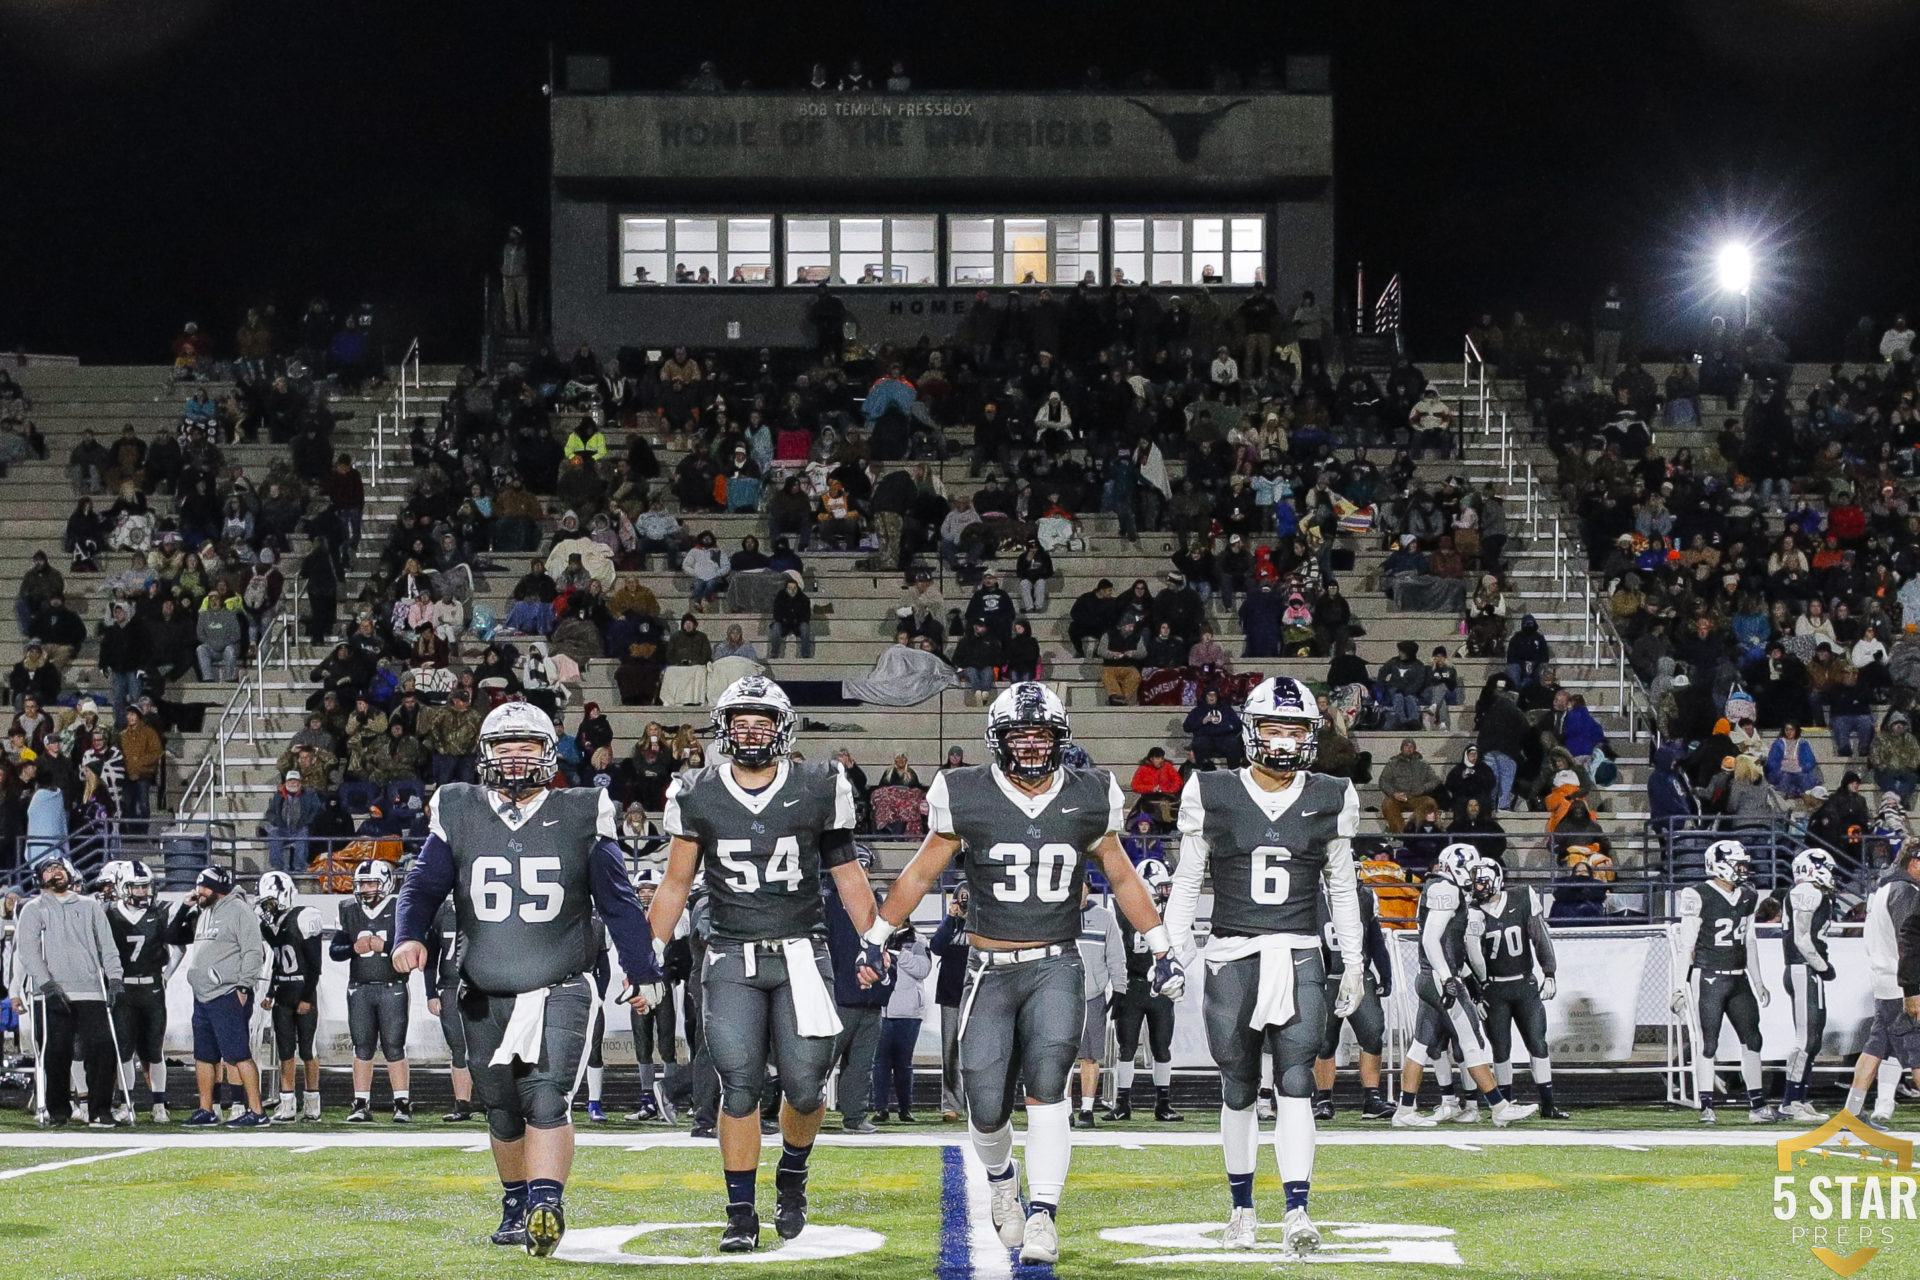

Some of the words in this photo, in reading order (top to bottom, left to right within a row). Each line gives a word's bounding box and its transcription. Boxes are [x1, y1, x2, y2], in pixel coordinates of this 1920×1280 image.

[799, 103, 828, 116] BOB
[835, 103, 892, 116] TEMPLIN
[898, 103, 973, 116] PRESSBOX
[659, 120, 756, 148] HOME
[778, 120, 826, 148] OF
[924, 119, 1113, 148] MAVERICKS
[889, 300, 966, 314] HOME
[717, 835, 804, 893] 54
[989, 843, 1078, 903] 30
[1250, 845, 1292, 905] 6
[470, 856, 565, 923] 65
[1486, 925, 1524, 960] 70
[1714, 917, 1747, 947] 24
[126, 935, 146, 962] 7
